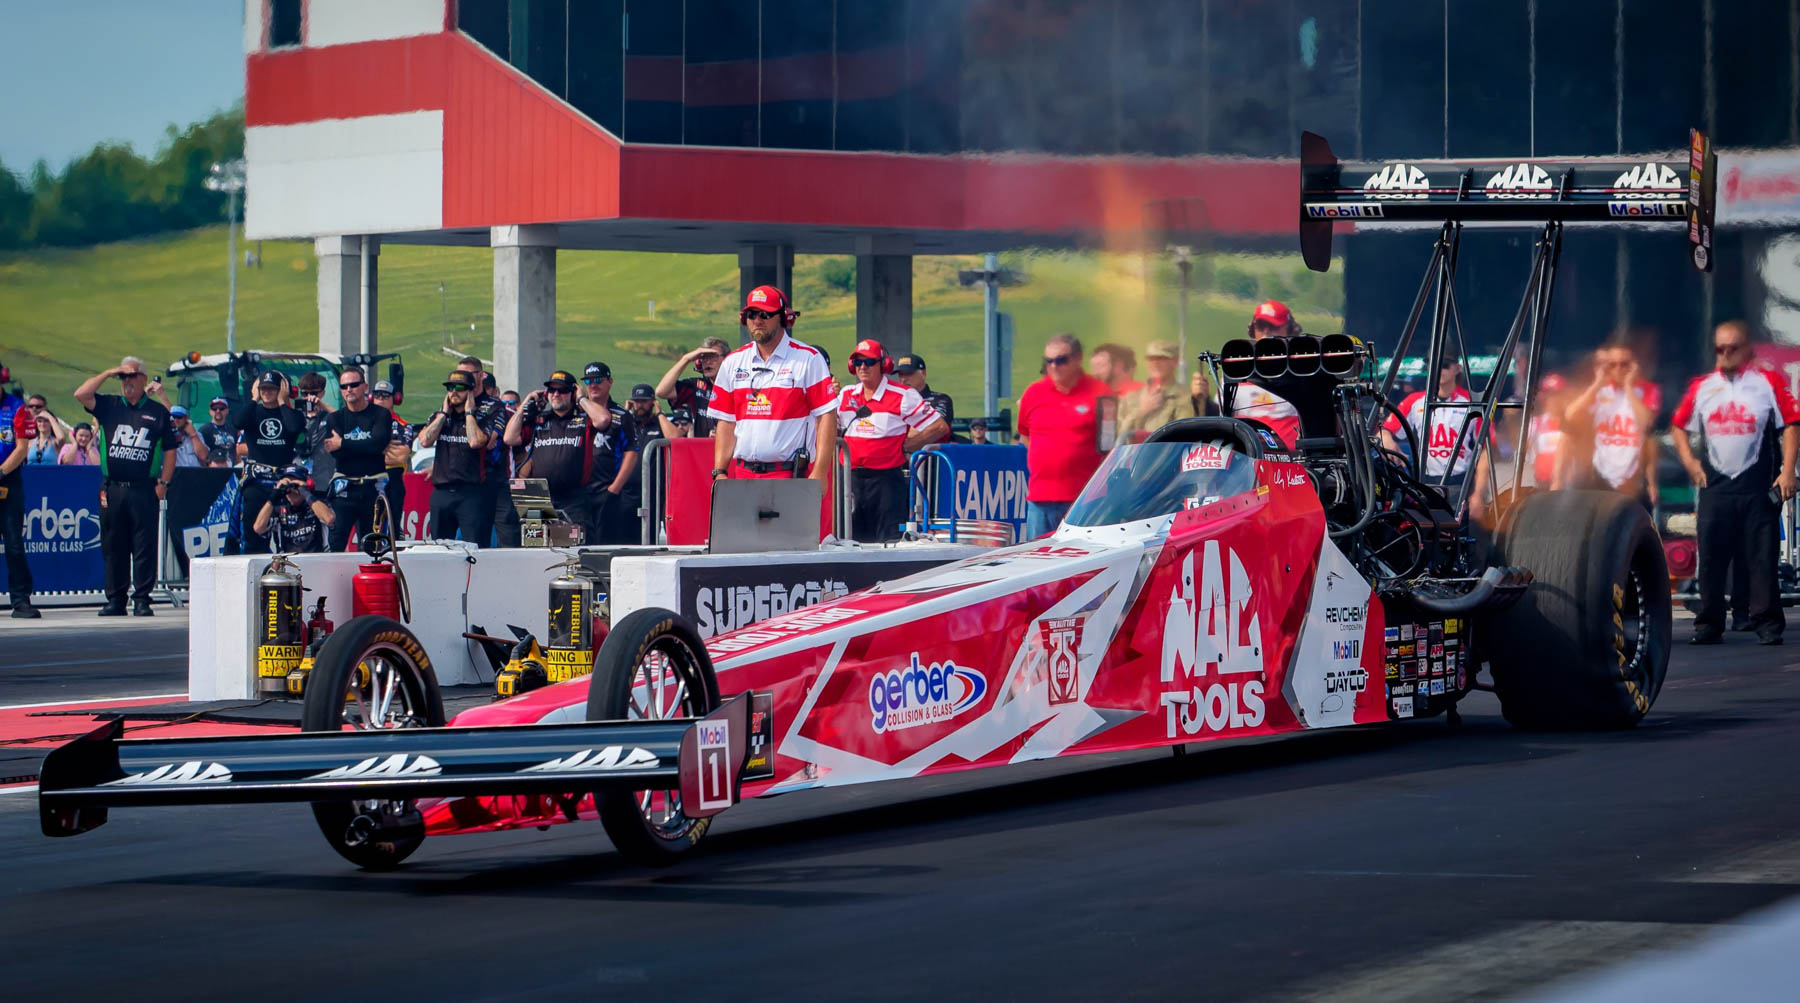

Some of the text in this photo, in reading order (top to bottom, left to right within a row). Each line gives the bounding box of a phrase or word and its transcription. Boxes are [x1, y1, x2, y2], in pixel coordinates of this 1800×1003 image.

[1364, 164, 1429, 189] MAC
[1486, 163, 1552, 188] MAC
[1614, 163, 1681, 188] MAC
[1309, 206, 1360, 217] Mobil
[1612, 203, 1663, 215] Mobil
[109, 445, 150, 461] CARRIERS
[1186, 445, 1221, 463] MAC
[1186, 461, 1222, 469] TOOLS
[955, 470, 1028, 520] CAMPIN
[52, 541, 57, 551] &
[60, 541, 84, 552] GLASS
[268, 590, 278, 640] FIREBULL
[570, 594, 581, 646] FIREBULL
[771, 607, 869, 632] DRIVE
[1161, 540, 1263, 682] MAC
[1326, 606, 1364, 623] REVCHEM
[264, 646, 301, 657] WARN
[1334, 640, 1352, 660] Mobil
[872, 657, 955, 730] gerber
[1325, 669, 1367, 694] DAYCO
[888, 703, 953, 727] COLLISION & GLASS
[1161, 680, 1265, 738] TOOLS
[700, 726, 727, 745] Mobil
[709, 752, 720, 797] 1
